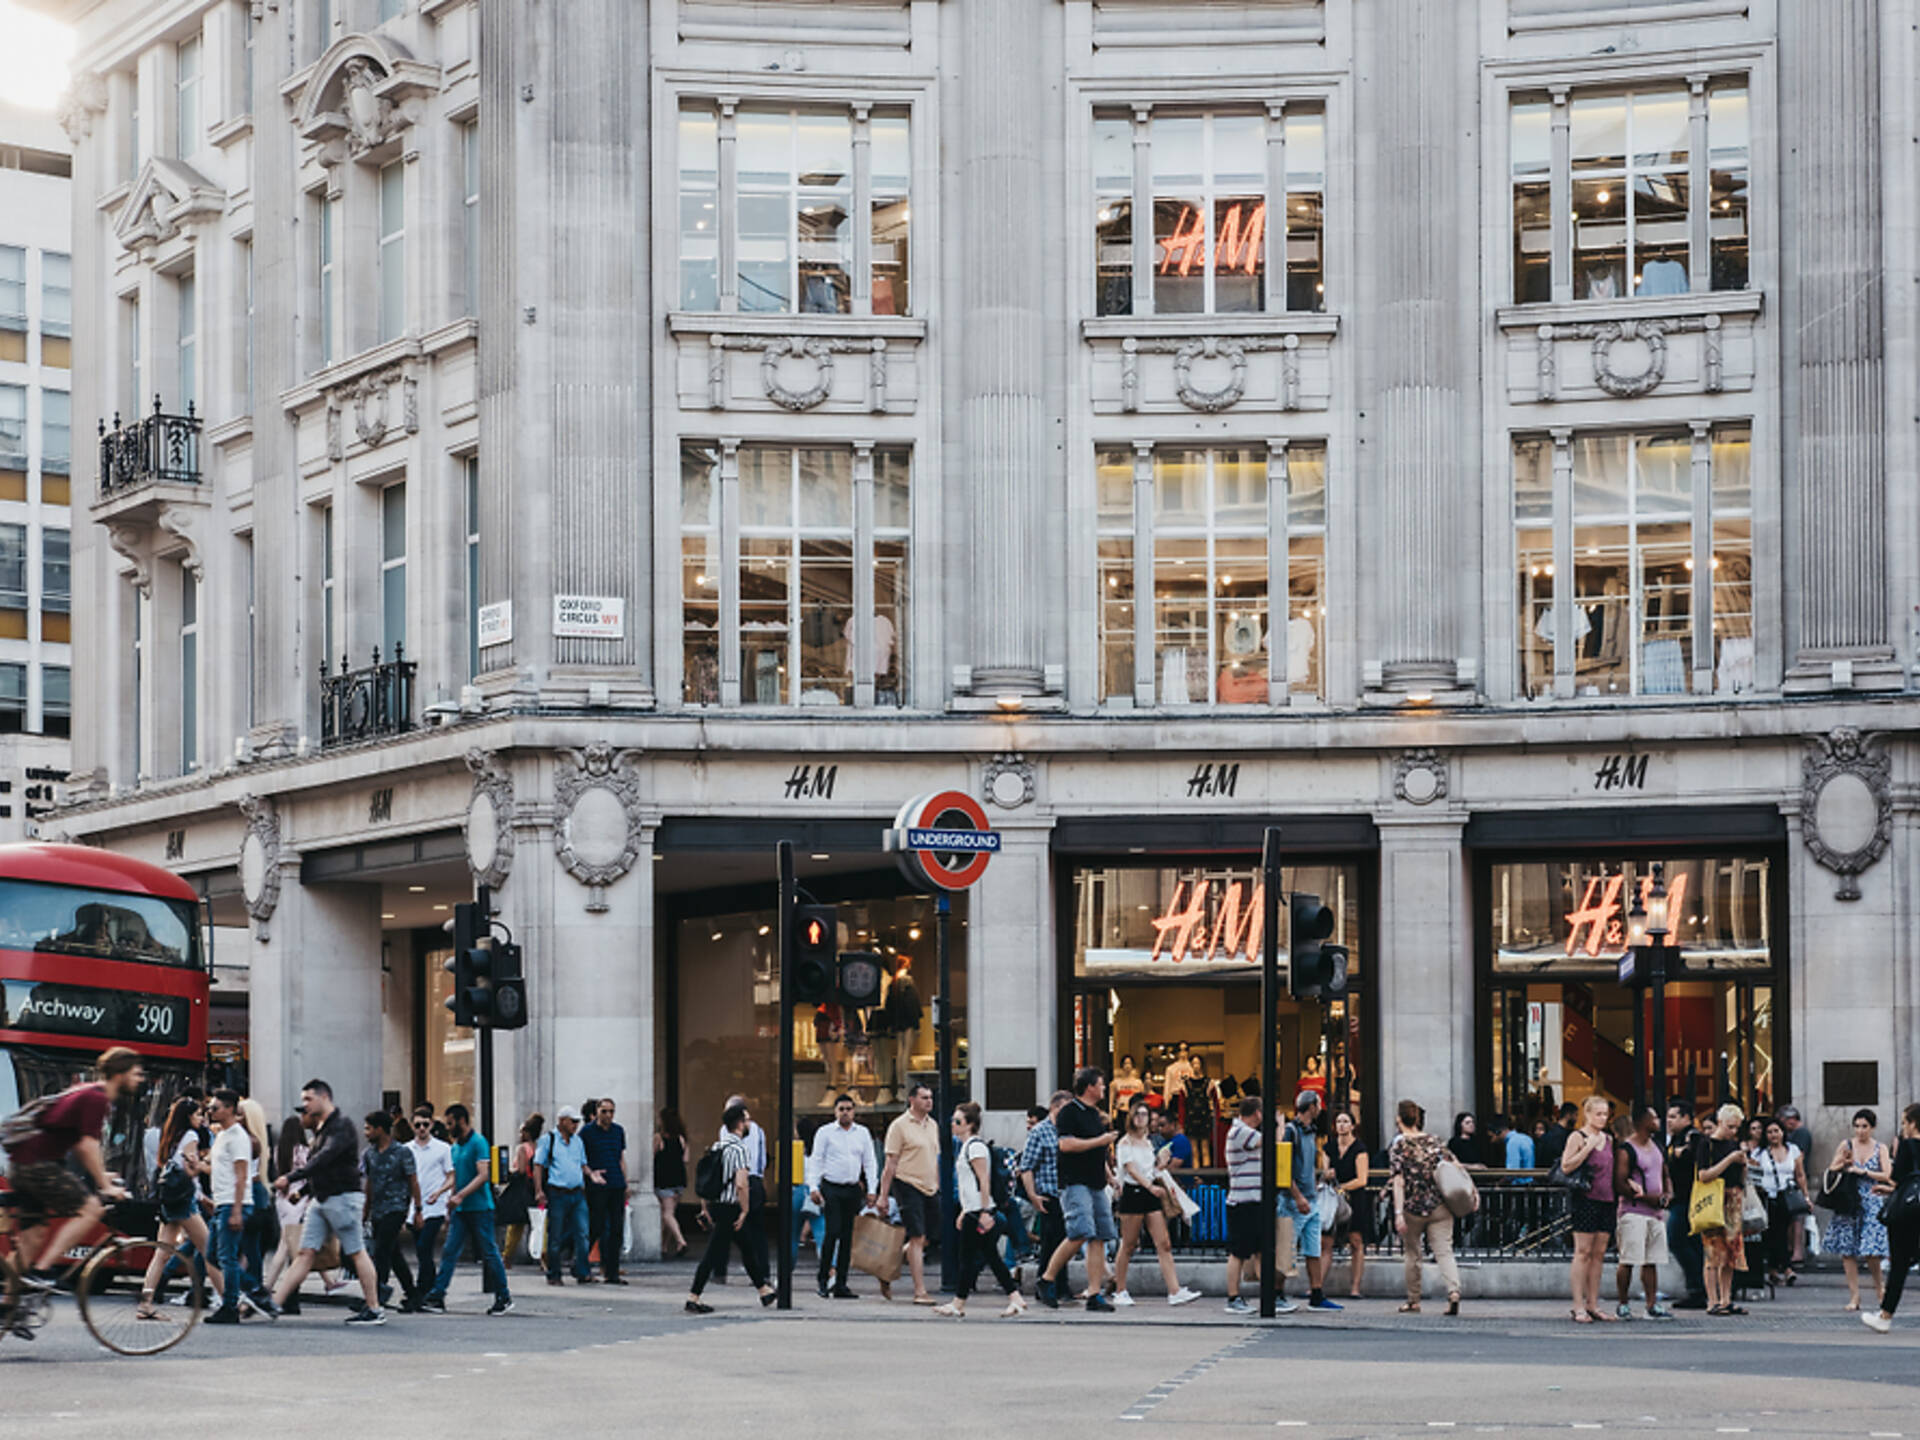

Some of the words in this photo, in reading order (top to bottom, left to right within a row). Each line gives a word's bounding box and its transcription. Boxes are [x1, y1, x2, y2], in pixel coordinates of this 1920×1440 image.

[559, 600, 603, 612] OXFORD
[559, 612, 599, 625] CIRCUS
[601, 614, 618, 625] W1
[785, 765, 838, 799] H&M
[1187, 763, 1240, 797] H&M
[1593, 755, 1649, 790] H&M
[910, 832, 998, 848] UNDERGROUND
[1151, 880, 1265, 964] H&M
[18, 996, 106, 1025] Archway
[136, 1004, 174, 1036] 390
